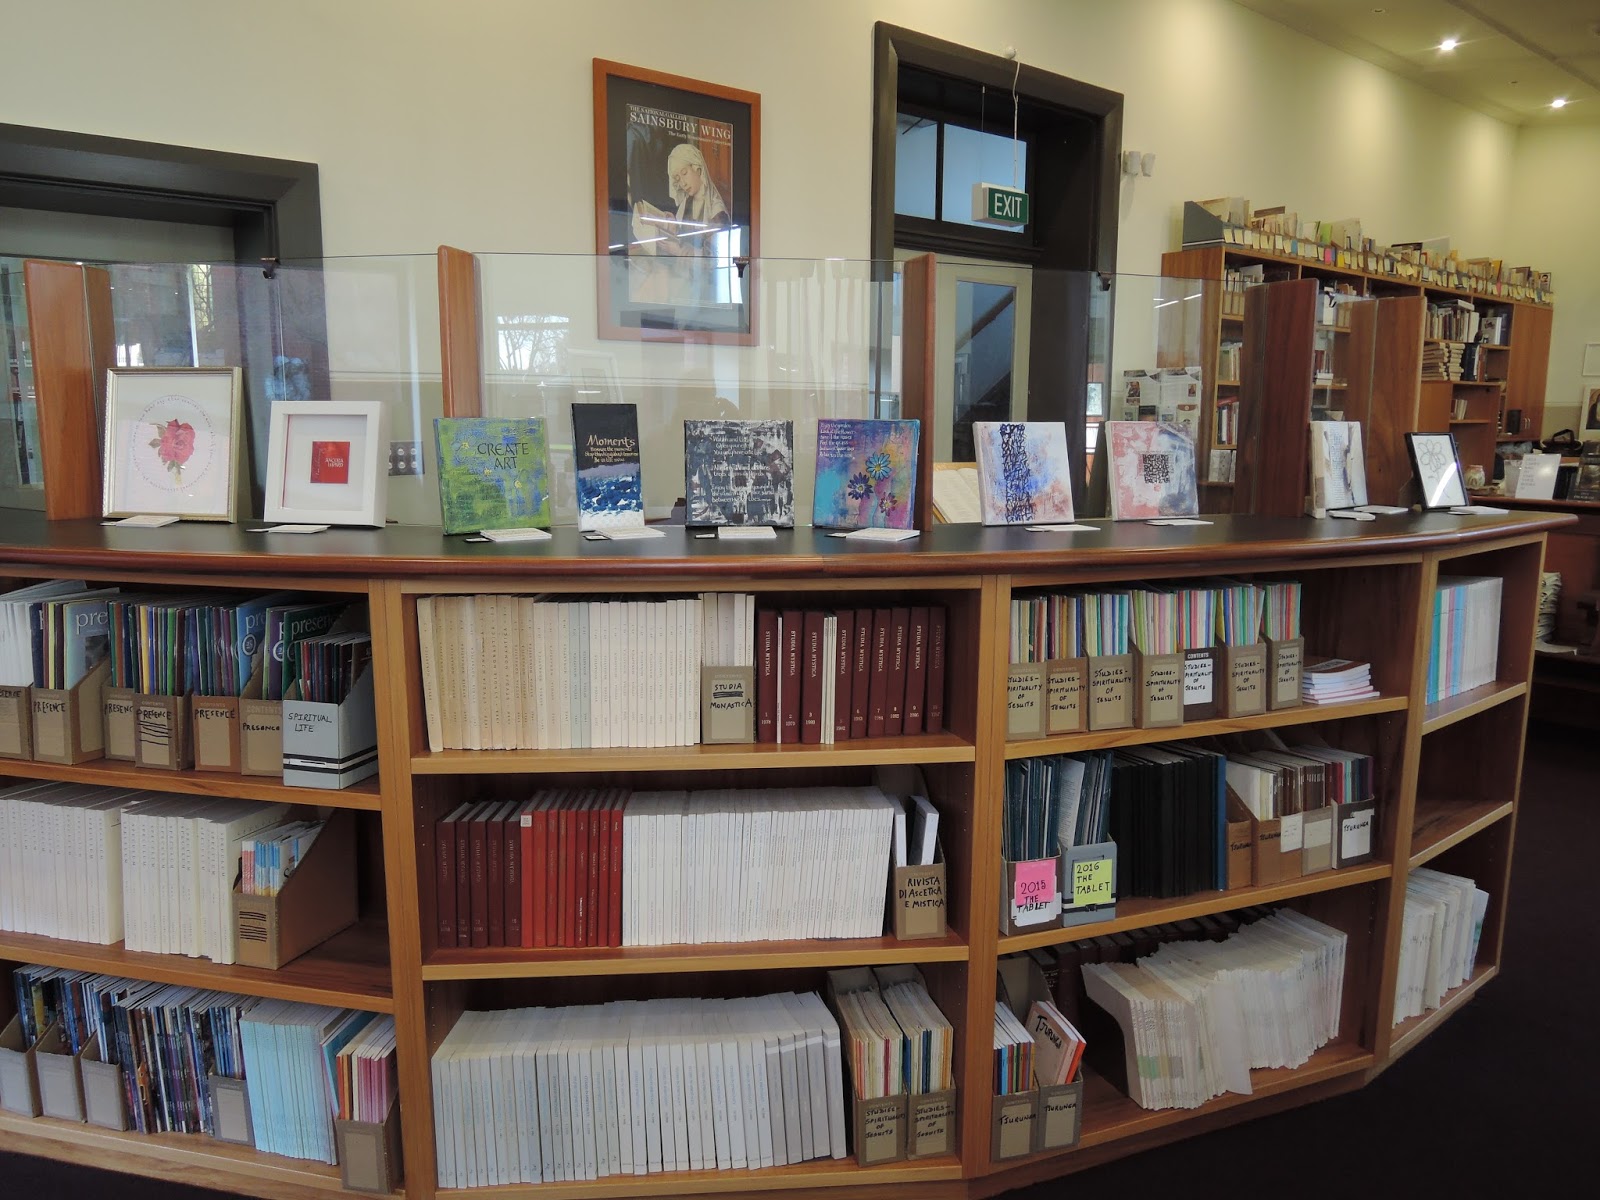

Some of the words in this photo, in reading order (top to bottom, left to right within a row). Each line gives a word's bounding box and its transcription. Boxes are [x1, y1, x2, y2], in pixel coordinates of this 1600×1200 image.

[630, 112, 698, 133] SAINSBURY
[701, 126, 731, 140] WING
[994, 193, 1022, 218] EXIT
[586, 435, 636, 447] Moments
[477, 442, 529, 456] CREATE
[494, 456, 517, 470] ART
[715, 682, 742, 691] STUDIA
[1007, 684, 1042, 692] PIRITUALITY
[33, 701, 66, 712] PRESENCE
[104, 703, 133, 715] PRESENC
[710, 698, 752, 710] MONASTICA
[136, 708, 172, 720] PRESENCE
[194, 709, 235, 720] PRESENCE
[288, 713, 332, 723] SPIRITUAL
[294, 724, 314, 732] LIFE
[1077, 862, 1100, 874] 2016
[907, 876, 940, 887] RIVISTA
[1077, 874, 1092, 883] THE
[1021, 880, 1046, 894] 2015
[1076, 882, 1110, 894] TABLET
[899, 889, 907, 899] DI
[1024, 895, 1039, 903] THE
[912, 899, 944, 908] MISTICA
[1017, 902, 1050, 913] TABLET
